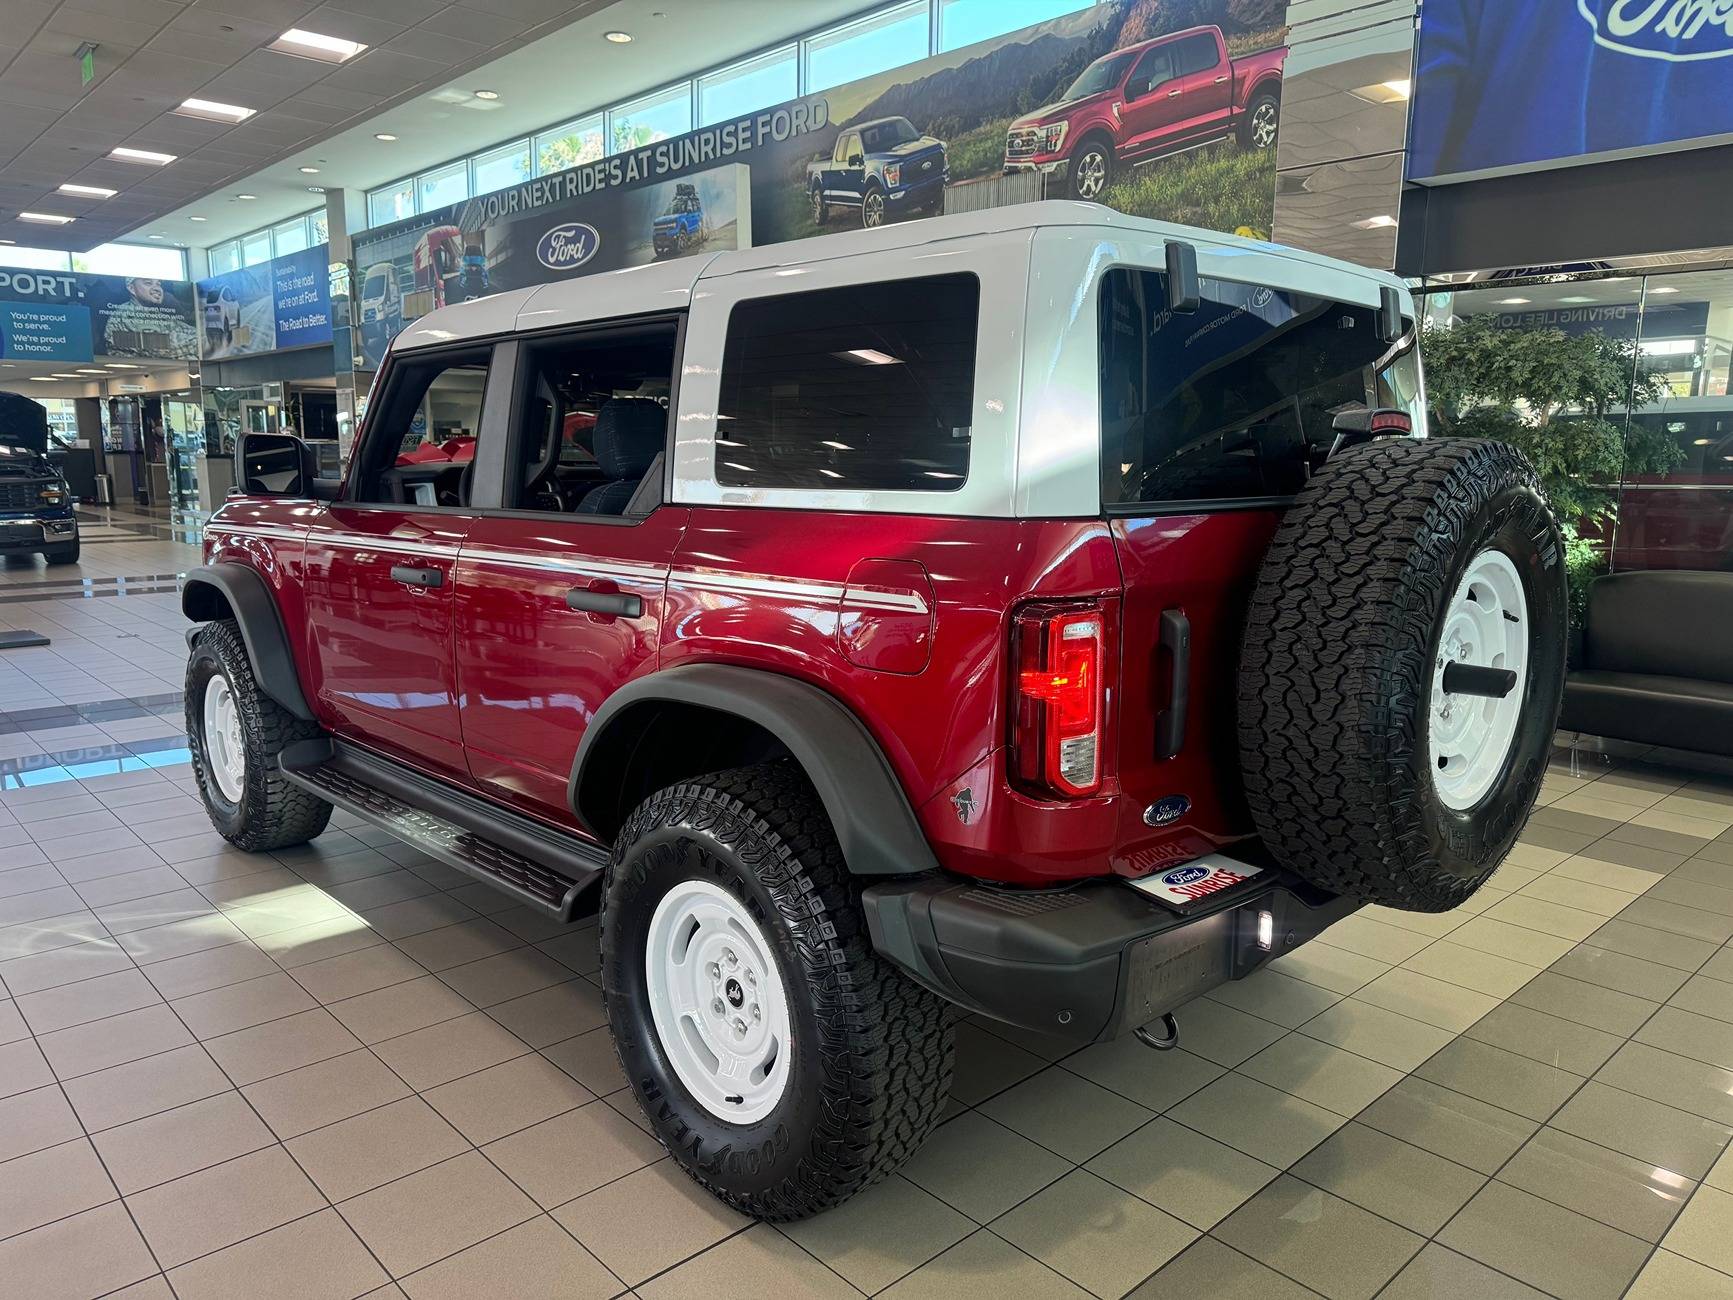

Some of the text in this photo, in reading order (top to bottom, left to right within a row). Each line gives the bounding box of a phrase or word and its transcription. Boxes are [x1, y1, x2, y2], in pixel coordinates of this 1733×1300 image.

[478, 99, 829, 220] YOUR NEXT RIDE'S AT SUNRISE FORD
[277, 280, 288, 293] This
[293, 277, 302, 289] the
[301, 272, 315, 287] road
[10, 312, 67, 323] You're proud
[279, 319, 290, 332] The
[290, 316, 302, 330] Road
[302, 316, 308, 328] to
[25, 323, 51, 331] serve.
[12, 334, 66, 345] We're proud
[25, 344, 54, 353] honor.
[1168, 868, 1248, 901] SUNRISE
